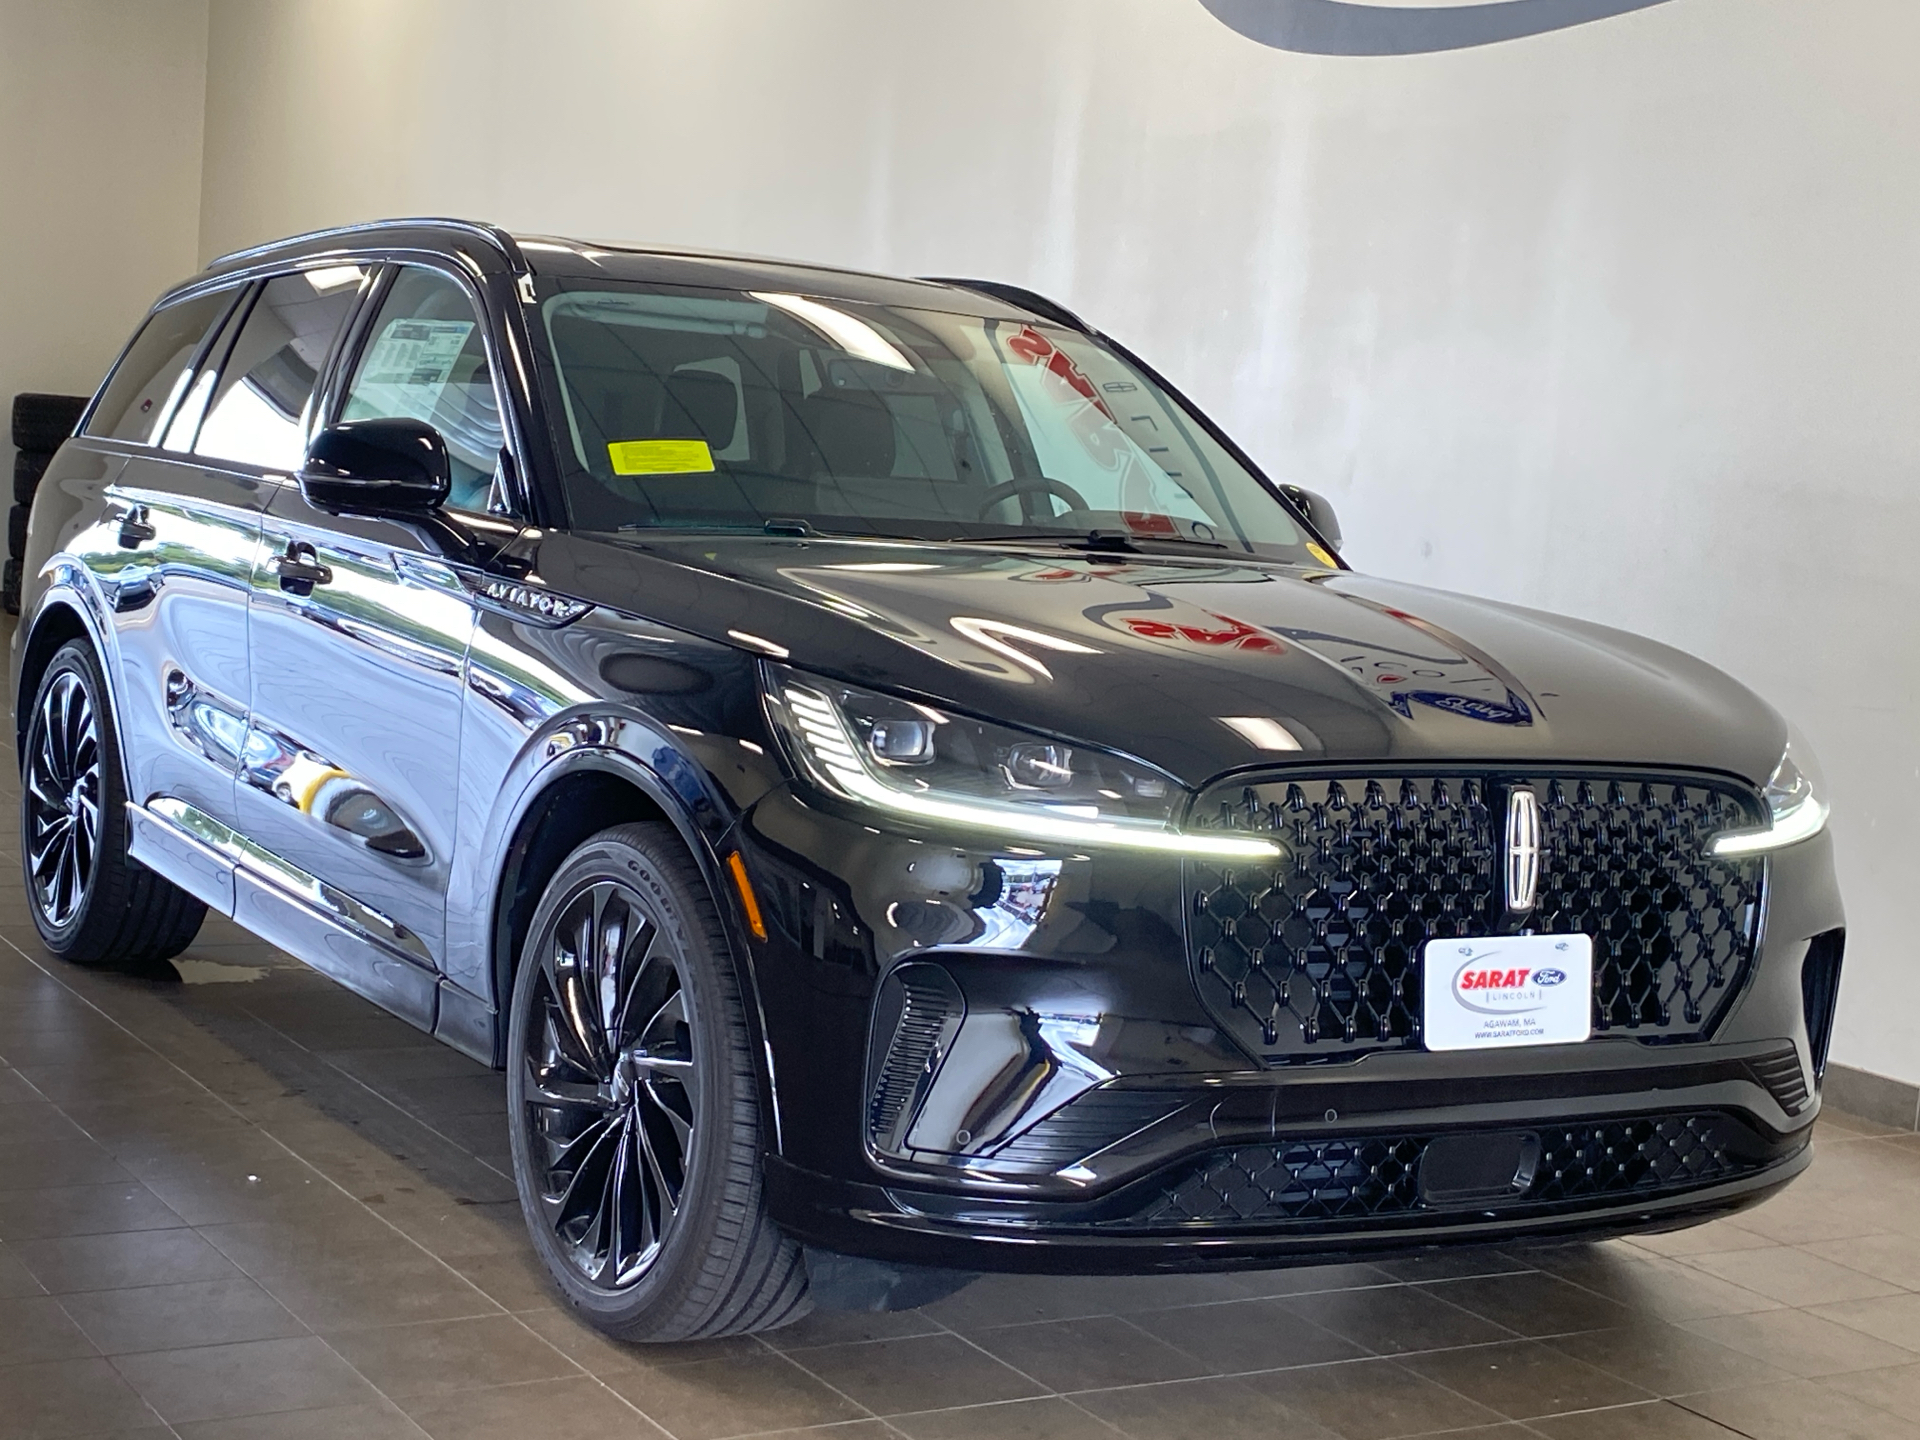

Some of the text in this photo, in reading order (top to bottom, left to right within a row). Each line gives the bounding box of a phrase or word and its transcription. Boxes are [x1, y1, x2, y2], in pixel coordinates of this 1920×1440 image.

[487, 582, 568, 617] AVIATOR
[1460, 968, 1562, 990] SARAT Ford
[1493, 991, 1535, 1001] LINCOLN
[1484, 1018, 1536, 1028] AGAWAM, MA
